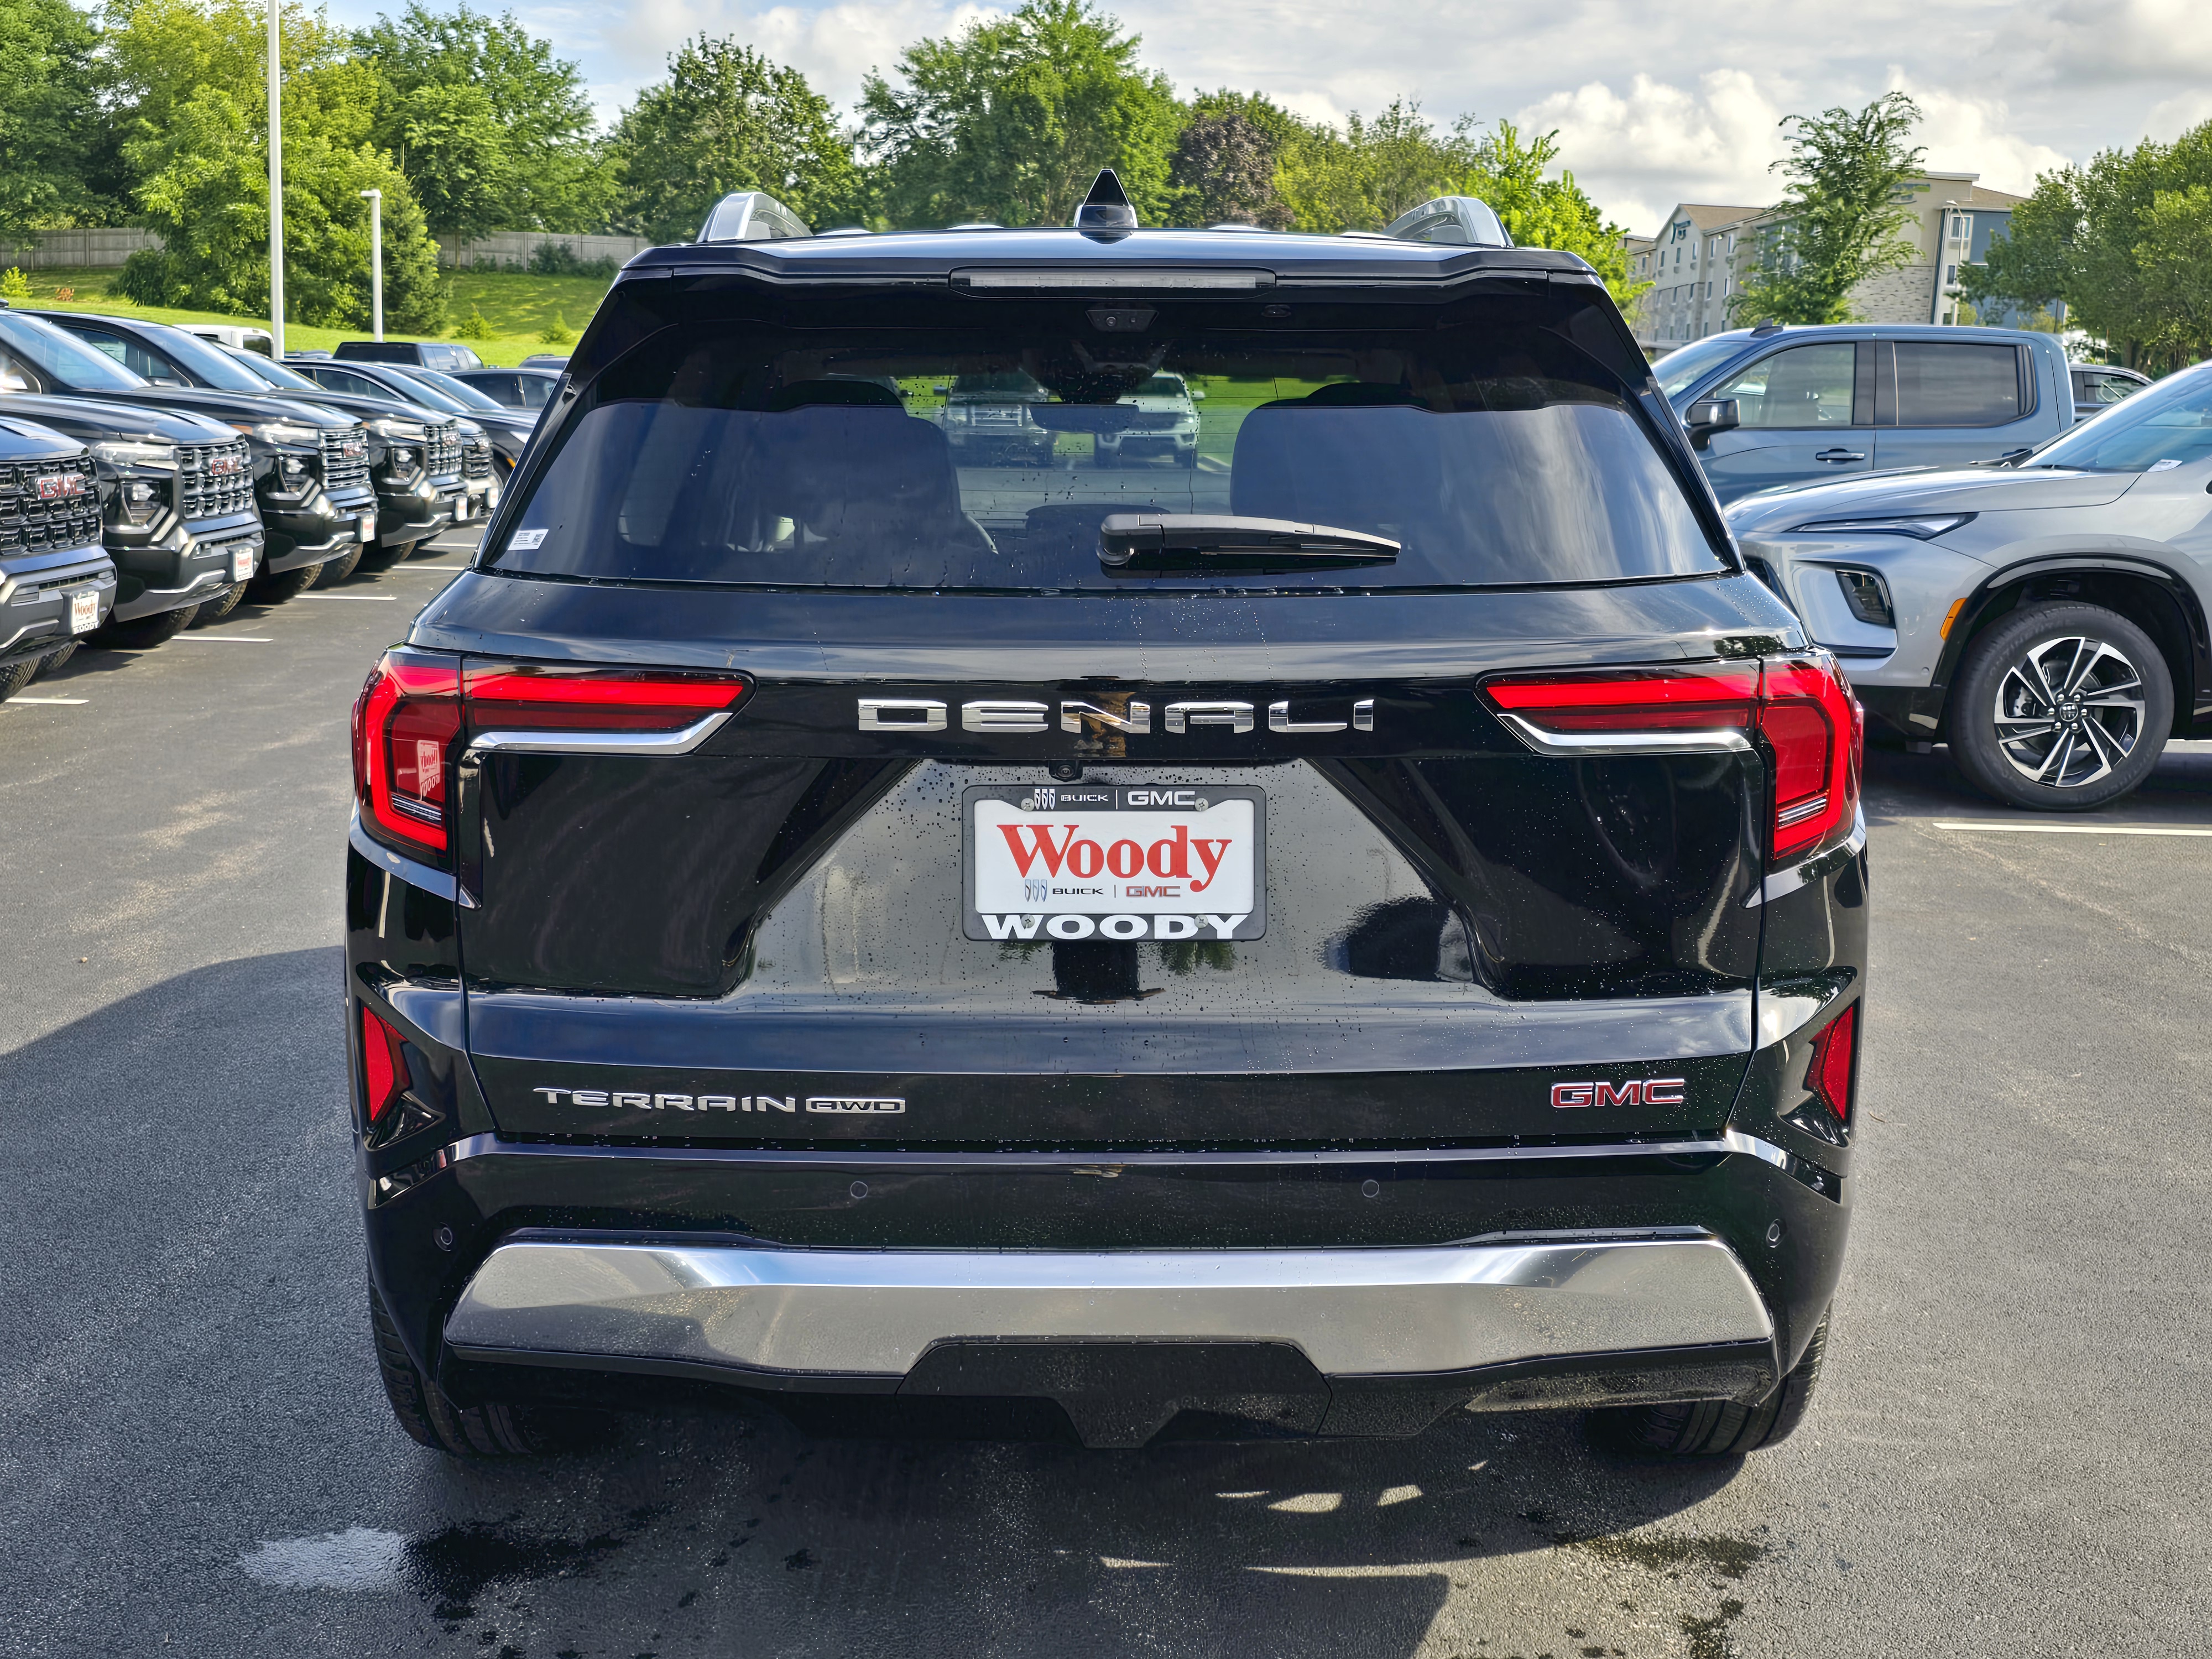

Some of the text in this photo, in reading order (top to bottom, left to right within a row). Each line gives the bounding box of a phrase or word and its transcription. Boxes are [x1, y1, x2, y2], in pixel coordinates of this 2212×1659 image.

[36, 474, 85, 498] GMC
[858, 698, 1375, 734] DENALI
[1128, 791, 1196, 805] GMC
[997, 825, 1233, 893] Woody
[1125, 885, 1181, 897] GMC
[982, 914, 1248, 940] WOODY
[533, 1087, 904, 1113] TERRAIN AWD
[1550, 1078, 1685, 1108] GMC
